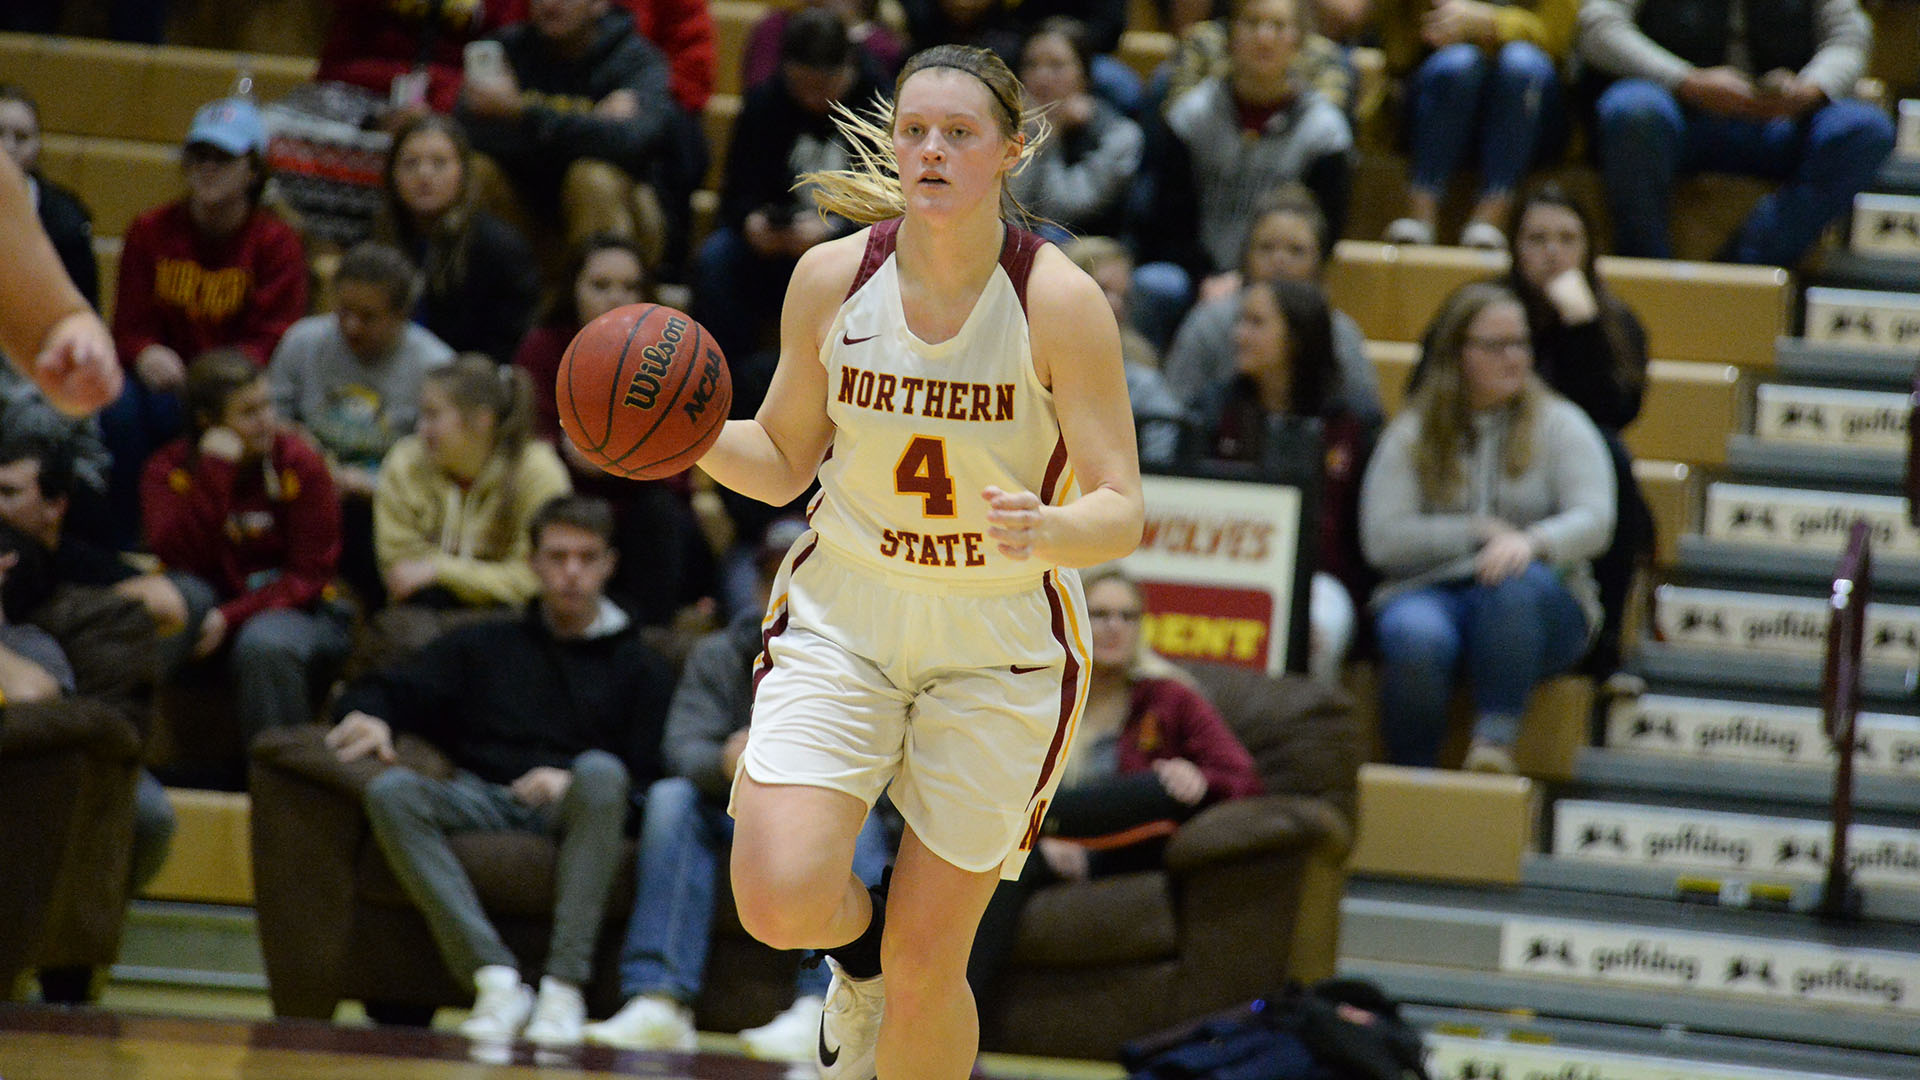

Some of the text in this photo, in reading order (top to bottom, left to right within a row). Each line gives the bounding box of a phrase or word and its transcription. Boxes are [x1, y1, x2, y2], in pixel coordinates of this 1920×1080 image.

[623, 315, 688, 411] Wilson
[683, 347, 722, 425] NCAA
[838, 365, 1016, 422] NORTHERN
[893, 433, 957, 519] 4
[880, 528, 986, 567] STATE
